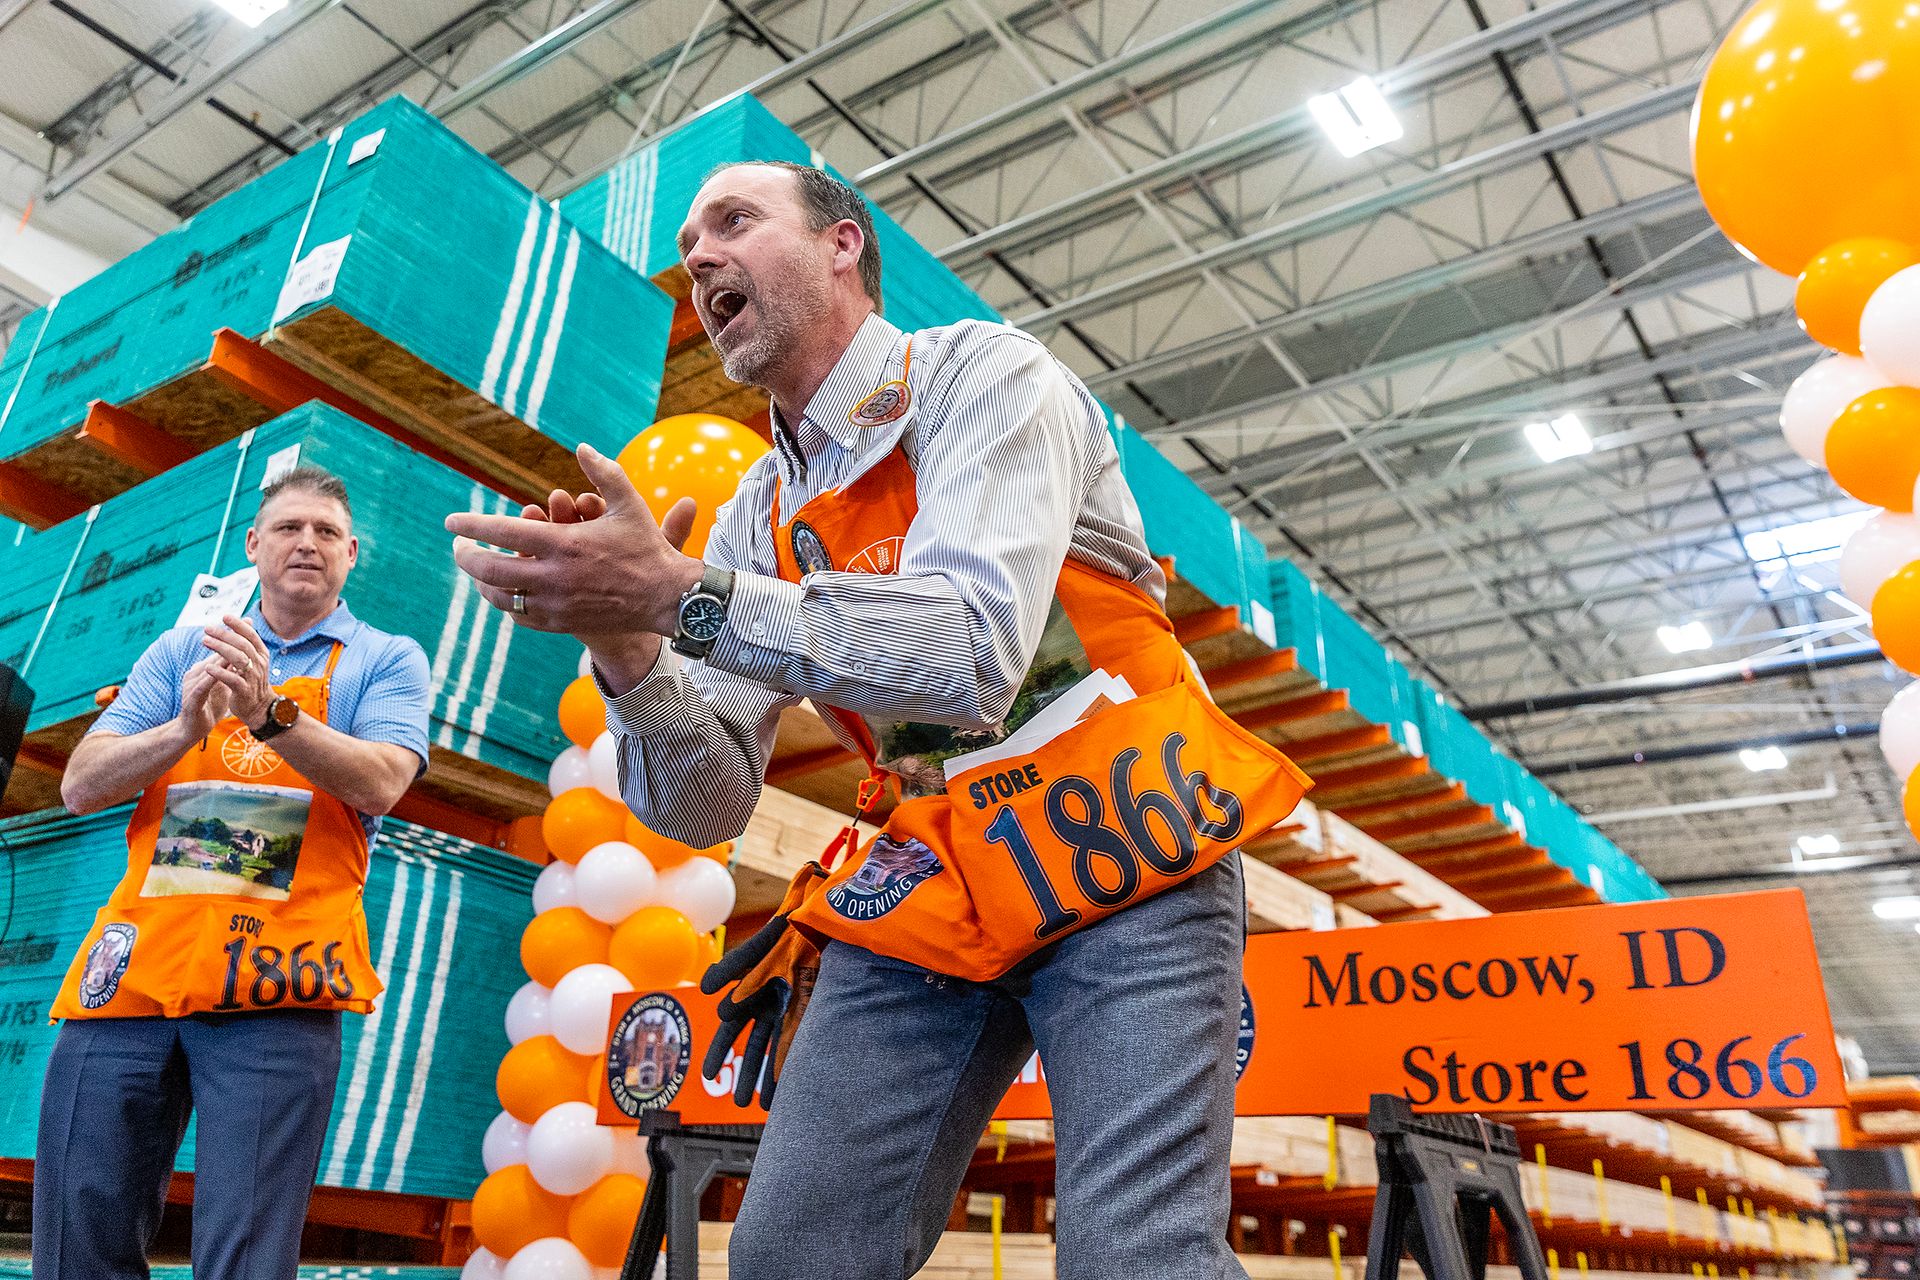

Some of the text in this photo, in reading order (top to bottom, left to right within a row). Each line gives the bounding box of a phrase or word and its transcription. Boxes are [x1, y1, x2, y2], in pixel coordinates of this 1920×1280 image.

[968, 762, 1043, 810] STORE
[984, 731, 1244, 941] 1866
[847, 877, 913, 917] OPENING
[213, 936, 353, 1010] 1866
[1303, 927, 1727, 1008] Moscow, ID
[611, 1076, 637, 1116] GRAND
[1403, 1032, 1817, 1105] Store 1866
